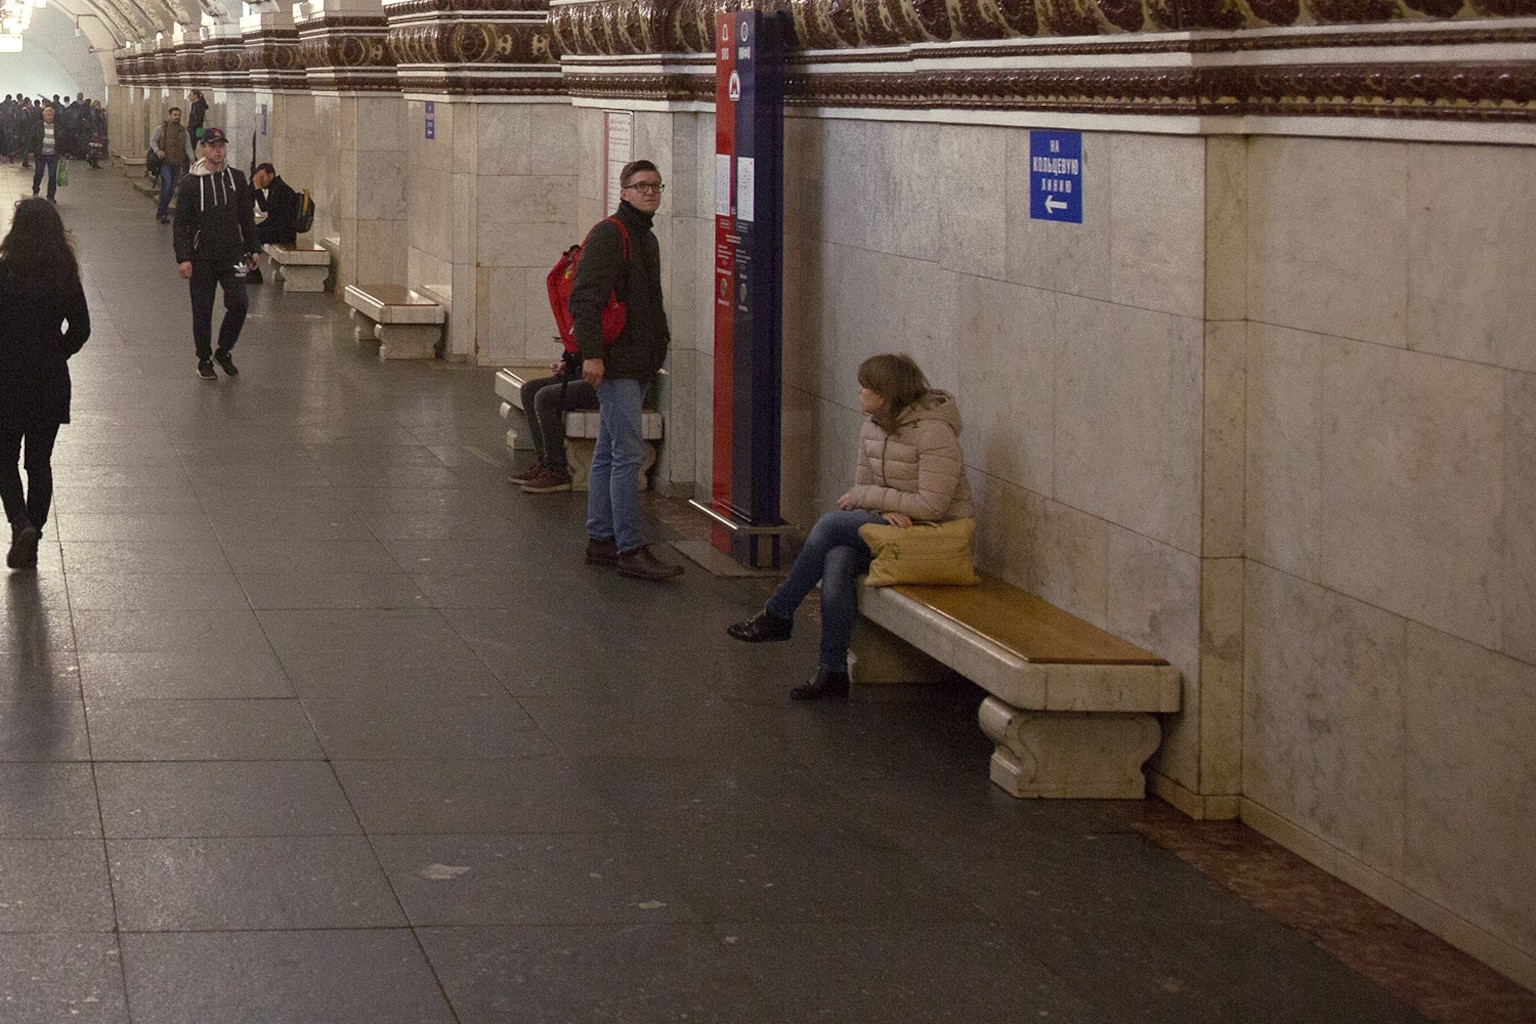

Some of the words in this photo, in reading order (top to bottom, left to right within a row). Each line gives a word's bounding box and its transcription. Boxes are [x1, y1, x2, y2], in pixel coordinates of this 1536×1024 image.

[1049, 139, 1060, 153] НА
[1033, 156, 1079, 176] КОЛЬЦЕВУЮ
[1041, 177, 1072, 194] ЛИНИЮ
